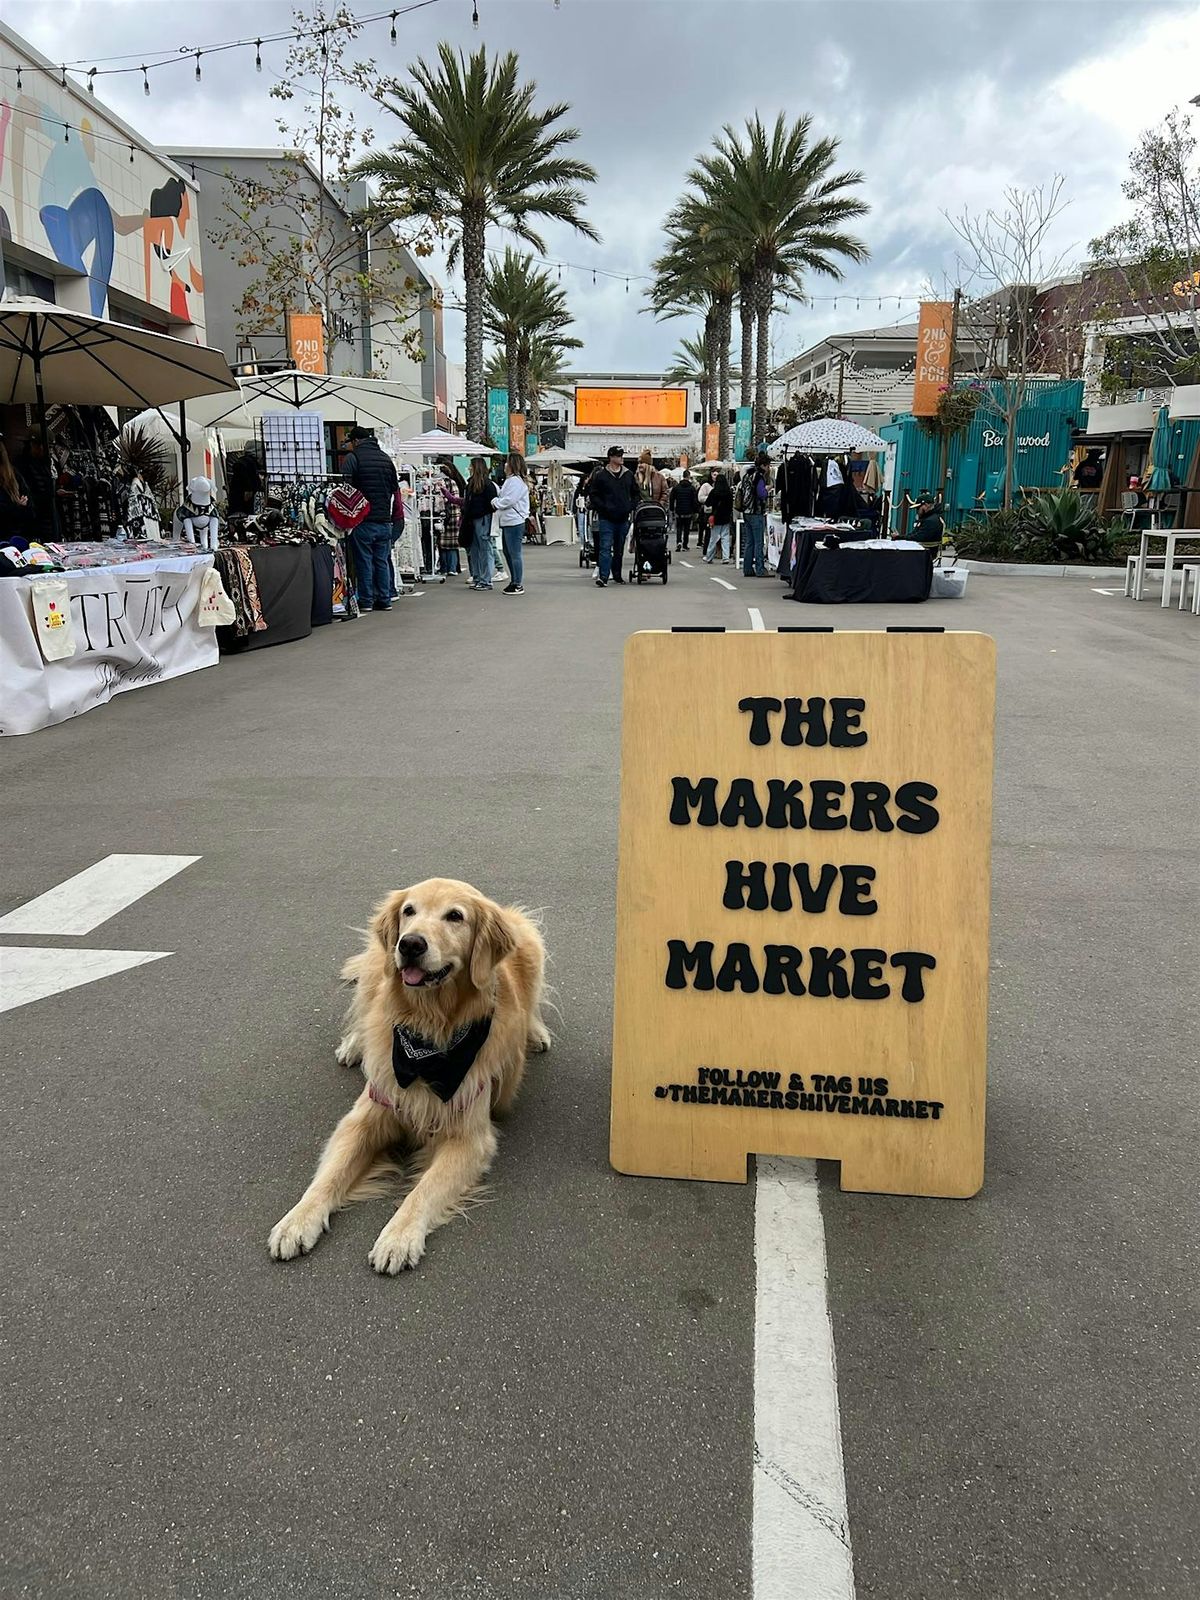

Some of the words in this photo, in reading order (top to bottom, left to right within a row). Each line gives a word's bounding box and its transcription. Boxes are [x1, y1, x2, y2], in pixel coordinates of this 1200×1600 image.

[296, 340, 318, 354] 2ND
[923, 328, 946, 343] 2ND
[920, 366, 945, 382] PCH
[738, 697, 867, 747] THE
[669, 776, 939, 834] MAKERS
[723, 860, 878, 915] HIVE
[665, 939, 936, 1003] MARKET
[698, 1067, 781, 1090] FOLLOW
[788, 1074, 804, 1092] &
[811, 1075, 852, 1094] TAG
[858, 1078, 889, 1096] US
[653, 1084, 944, 1119] @THEMAKERSHIVEMARKET
